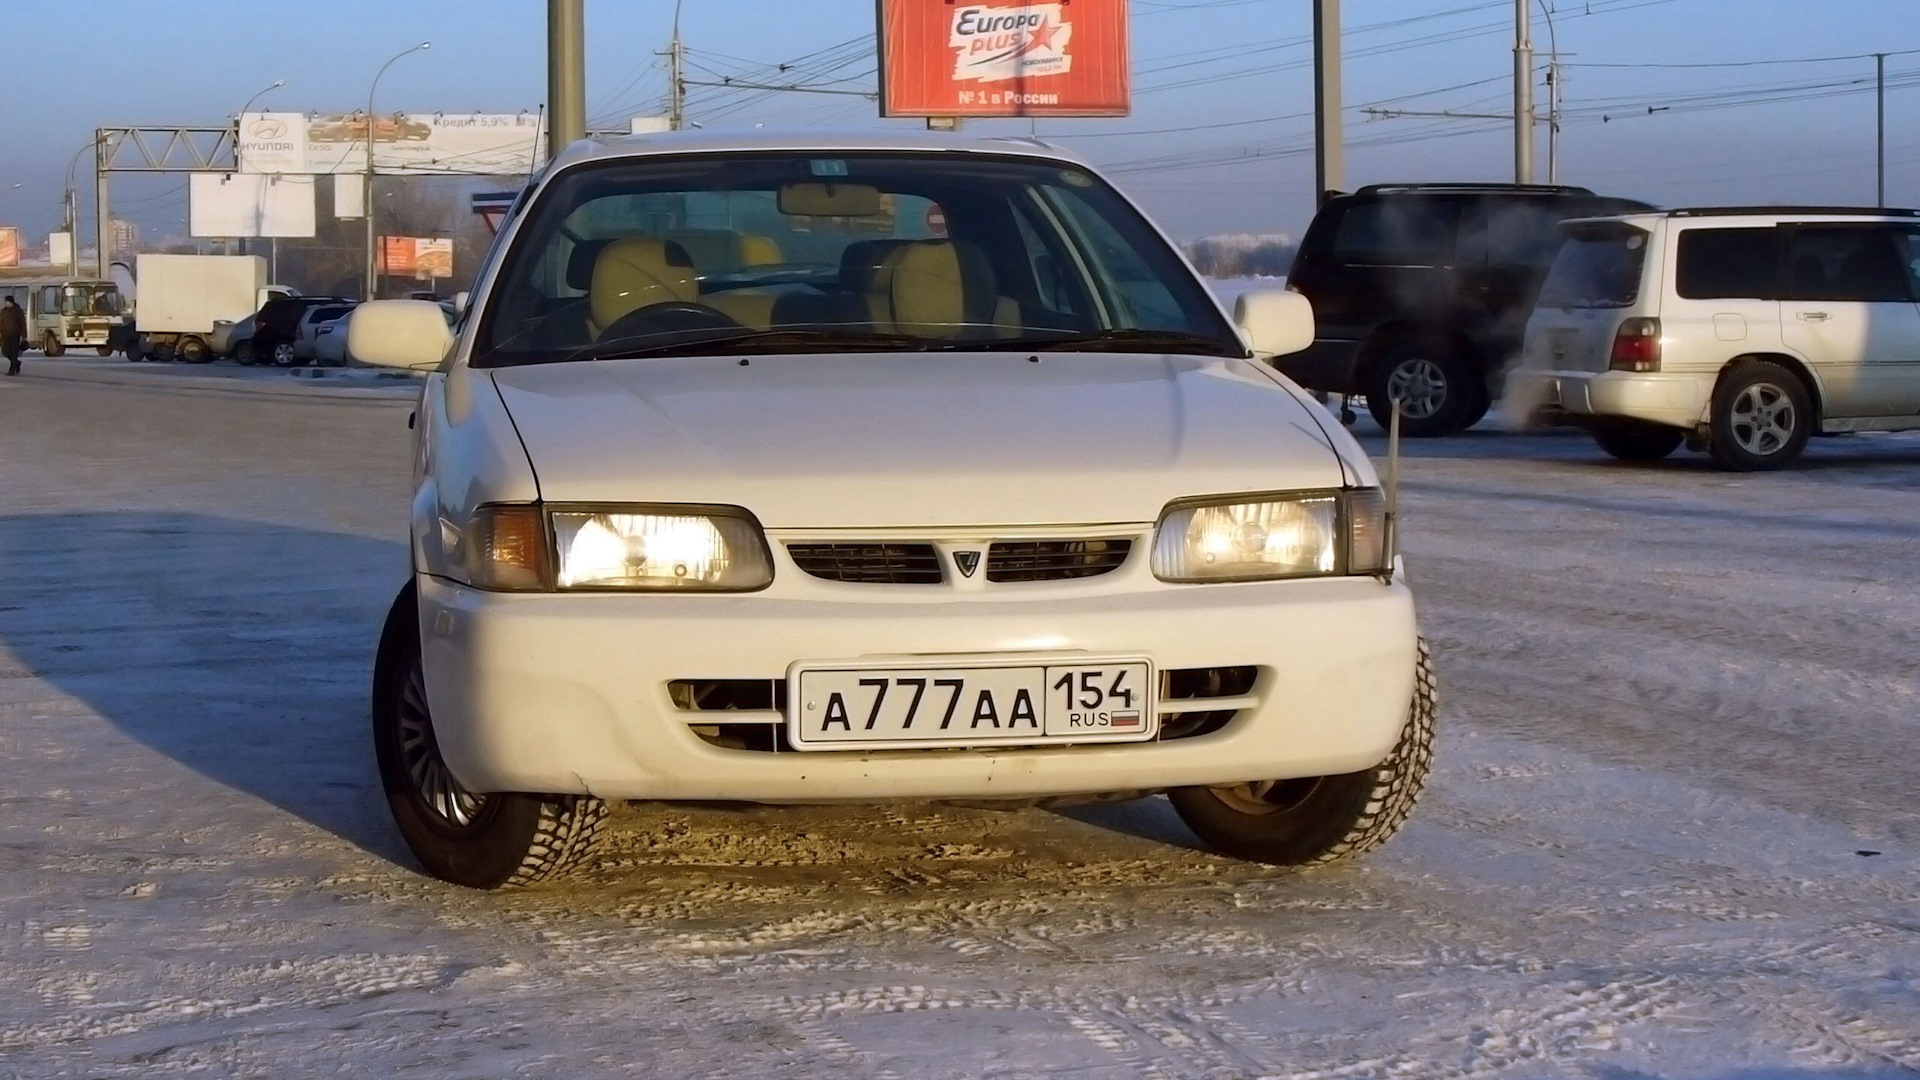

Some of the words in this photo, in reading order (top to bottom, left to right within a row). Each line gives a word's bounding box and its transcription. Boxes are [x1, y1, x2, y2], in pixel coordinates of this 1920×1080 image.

[956, 9, 1040, 36] Europa
[991, 93, 1001, 105] в
[1004, 90, 1058, 105] России
[433, 117, 476, 128] Кредит
[241, 142, 294, 151] HYUNDAI
[821, 677, 1038, 732] A777AA
[1053, 669, 1132, 711] 154
[1069, 712, 1109, 727] RUS
